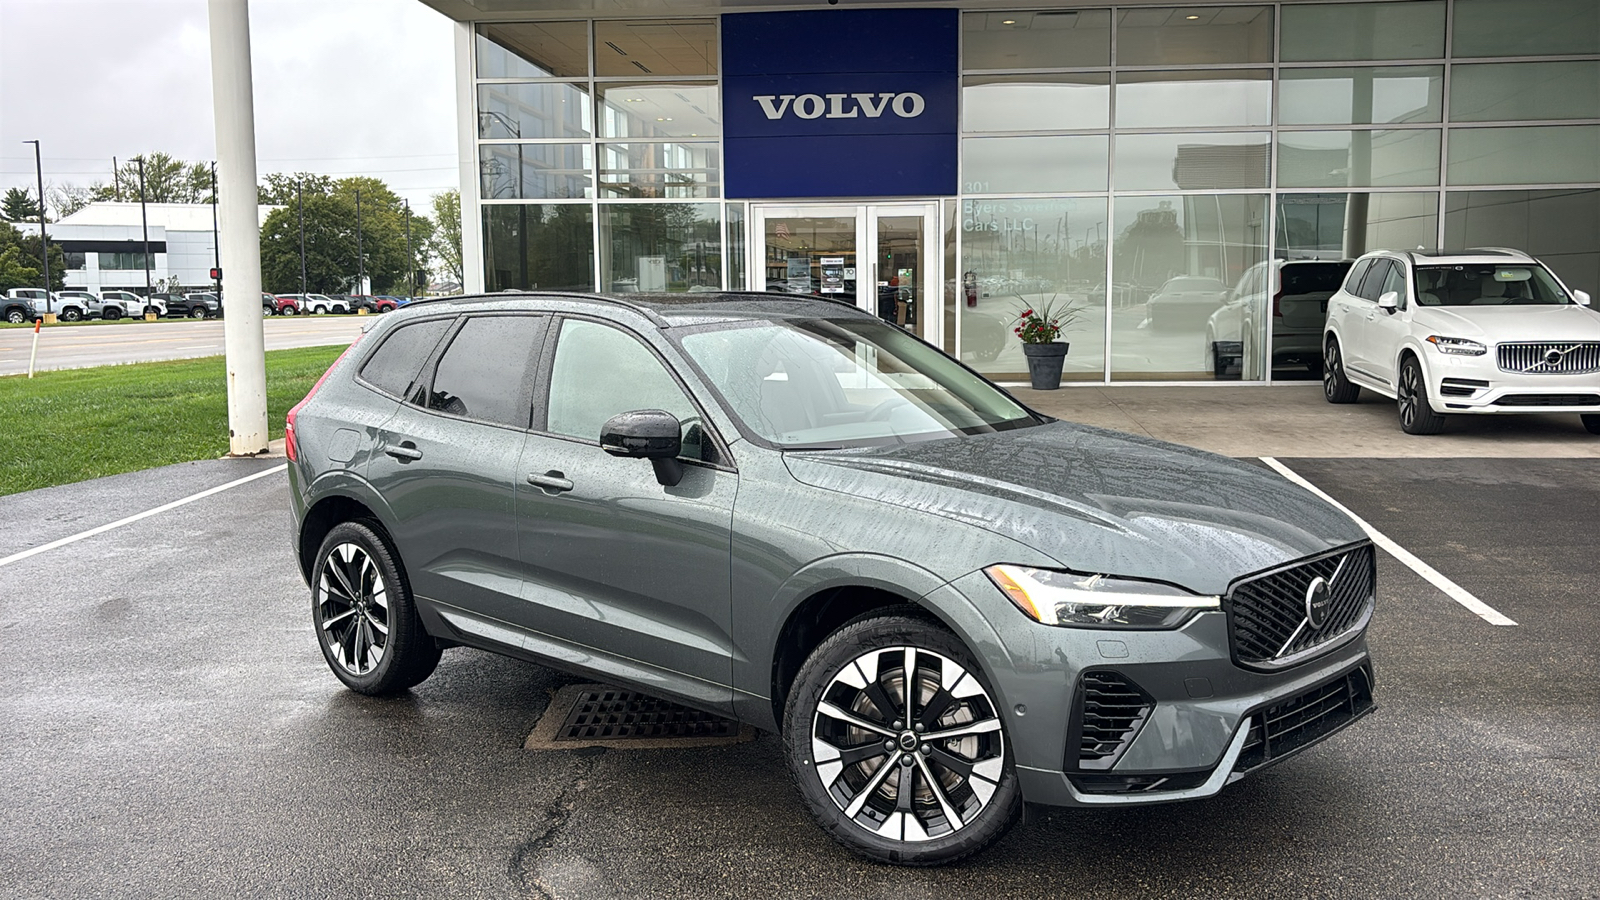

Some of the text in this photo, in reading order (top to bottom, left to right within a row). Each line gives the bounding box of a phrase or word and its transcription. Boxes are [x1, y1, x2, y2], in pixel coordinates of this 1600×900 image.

[752, 92, 926, 120] VOLVO
[964, 181, 989, 193] 301
[964, 202, 1007, 216] Byers
[963, 218, 1034, 232] Cars LLC
